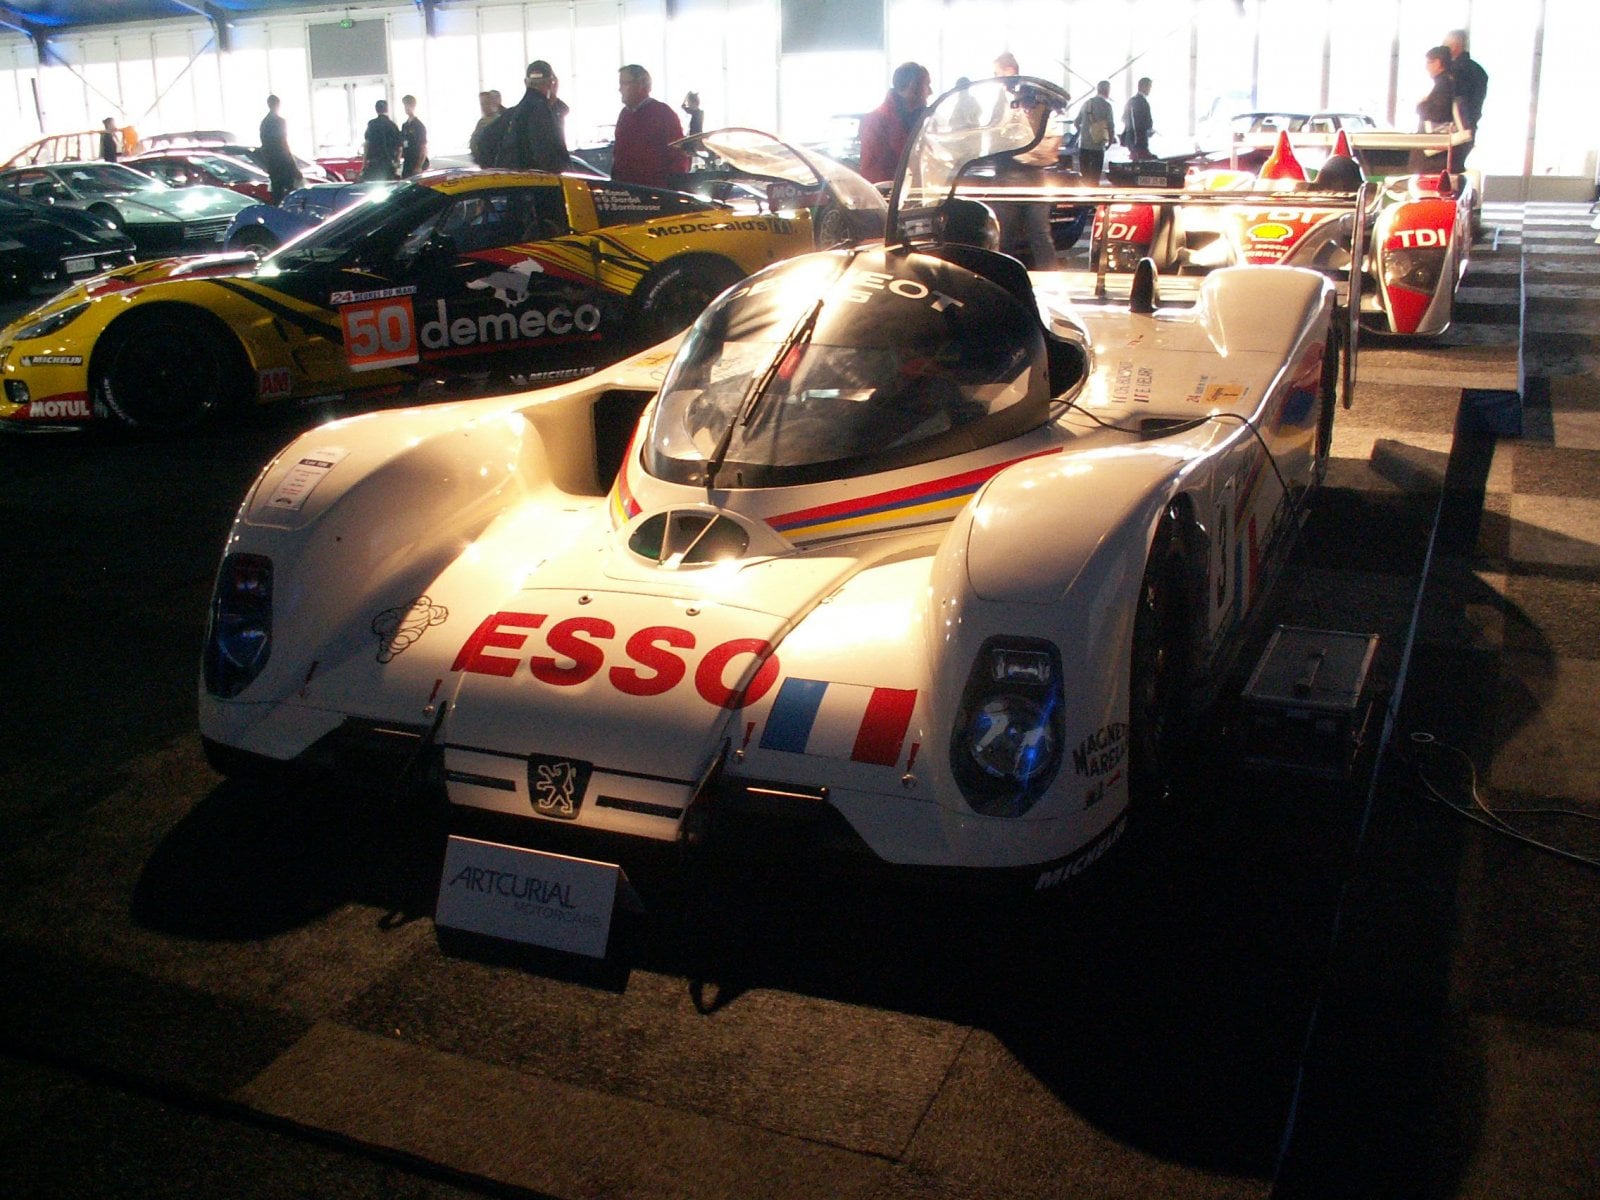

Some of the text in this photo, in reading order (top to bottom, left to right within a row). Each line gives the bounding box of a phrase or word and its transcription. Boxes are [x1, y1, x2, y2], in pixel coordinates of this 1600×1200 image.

[1394, 228, 1447, 248] TDI
[347, 305, 412, 357] 50
[420, 298, 601, 350] demeco
[31, 356, 83, 365] MICHELIN
[528, 366, 595, 382] MICHELIN
[29, 399, 90, 418] MOTUL
[450, 610, 782, 709] ESSO
[450, 865, 577, 909] ARTCURIAL
